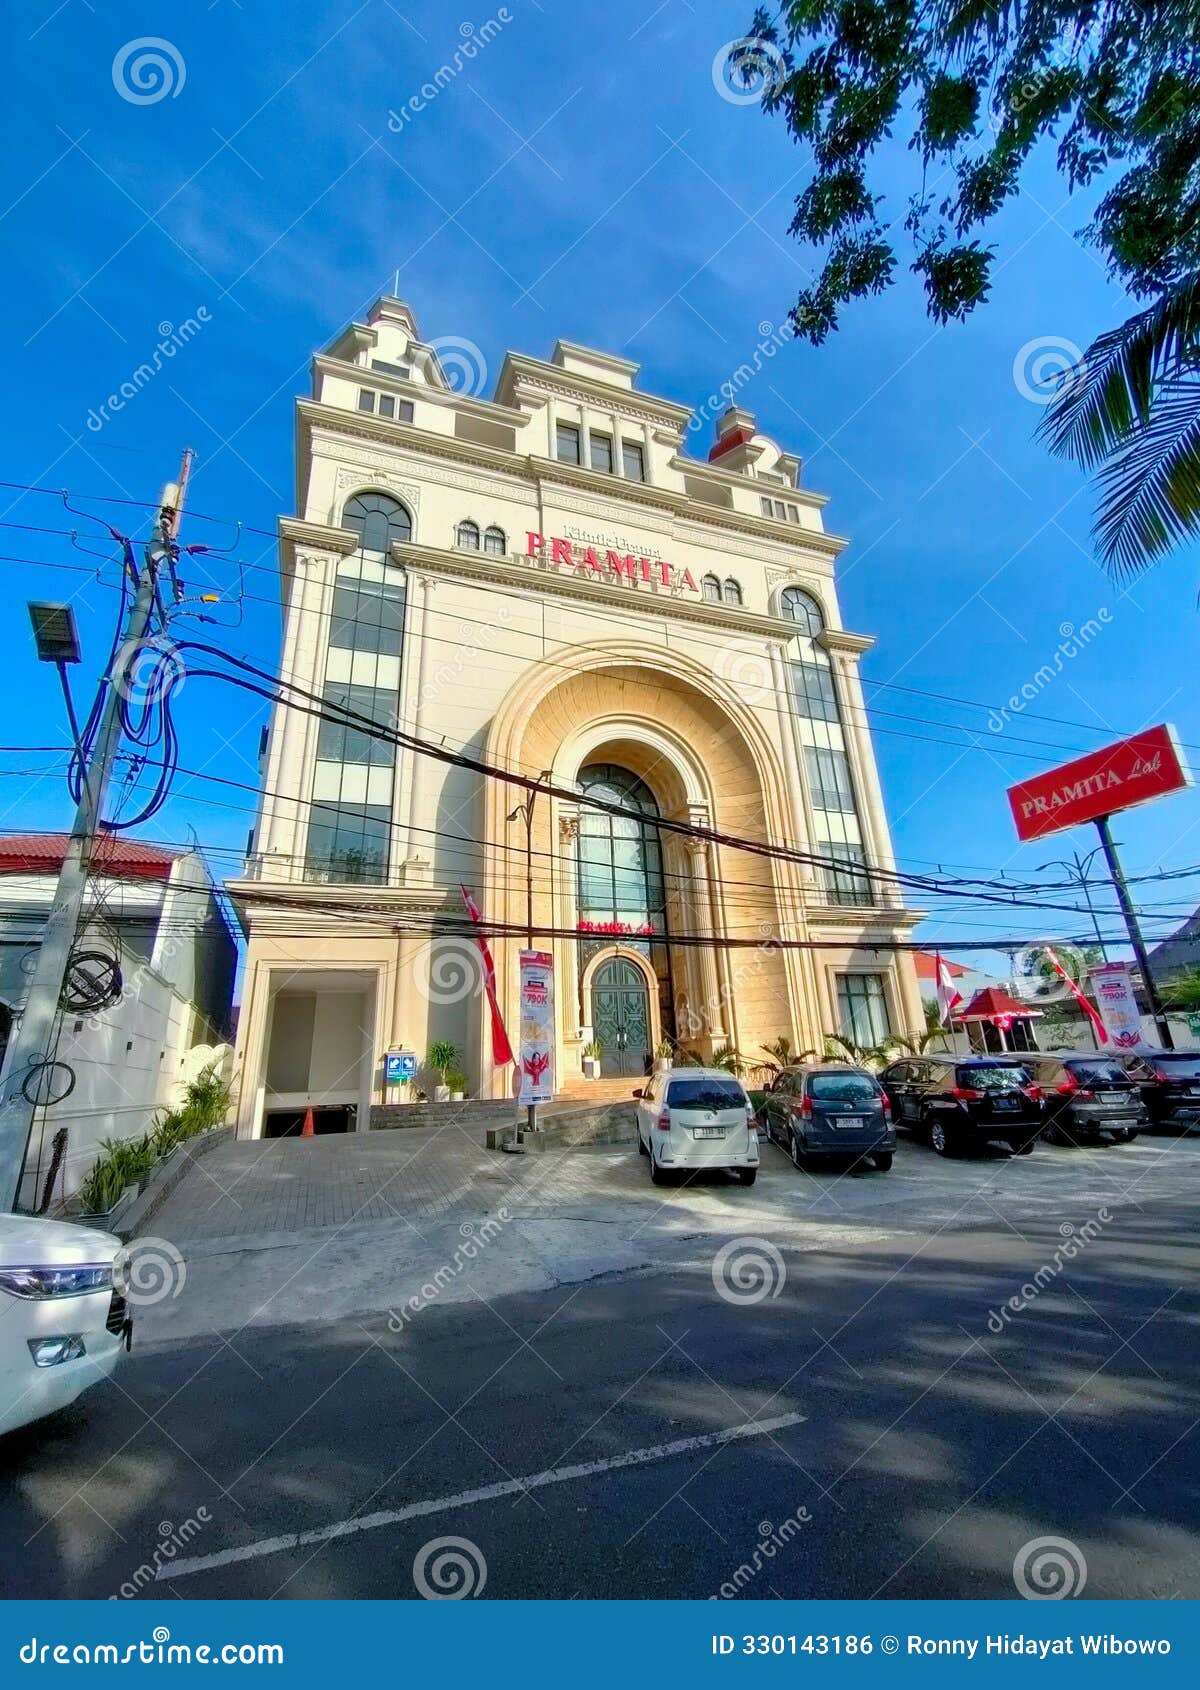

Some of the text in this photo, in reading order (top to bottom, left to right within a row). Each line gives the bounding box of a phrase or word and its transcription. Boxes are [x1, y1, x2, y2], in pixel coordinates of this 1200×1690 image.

[525, 530, 699, 592] PRAMITA
[1021, 750, 1161, 818] PRAMITA Lab
[526, 993, 548, 1005] 790K
